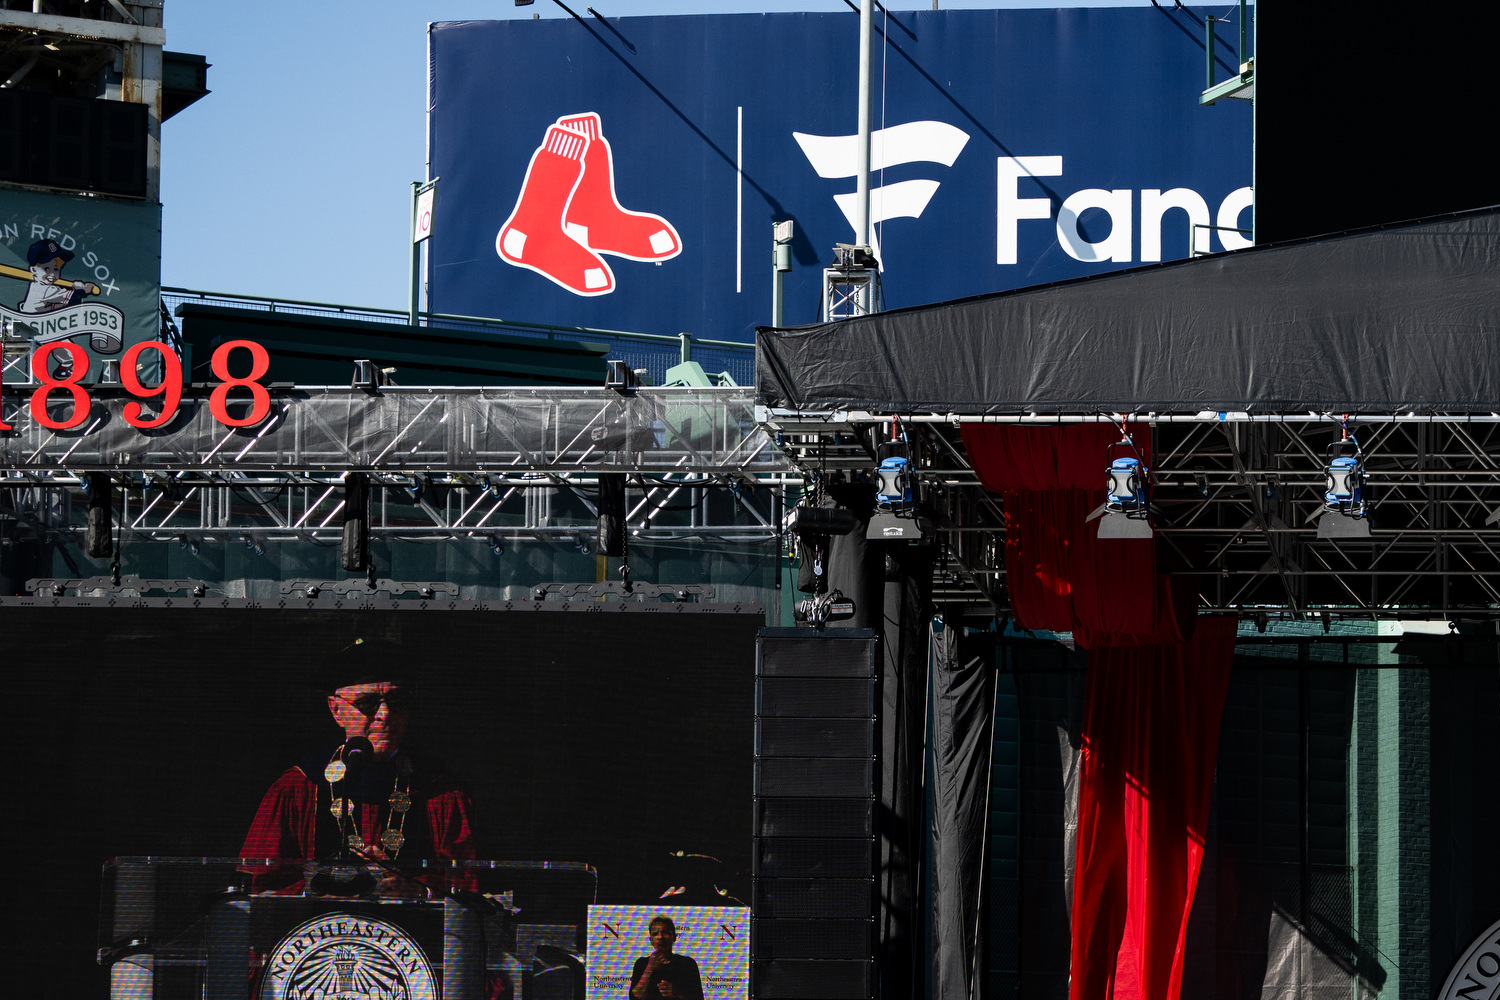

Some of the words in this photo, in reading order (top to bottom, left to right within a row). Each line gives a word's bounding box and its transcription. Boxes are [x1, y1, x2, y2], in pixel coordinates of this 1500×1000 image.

[0, 223, 19, 239] N
[82, 251, 121, 296] SOX
[30, 313, 79, 335] SINCE
[84, 310, 118, 330] 1953
[0, 340, 271, 431] 898
[272, 922, 423, 981] NORTHEASTERN
[603, 923, 622, 939] N
[720, 925, 738, 941] N
